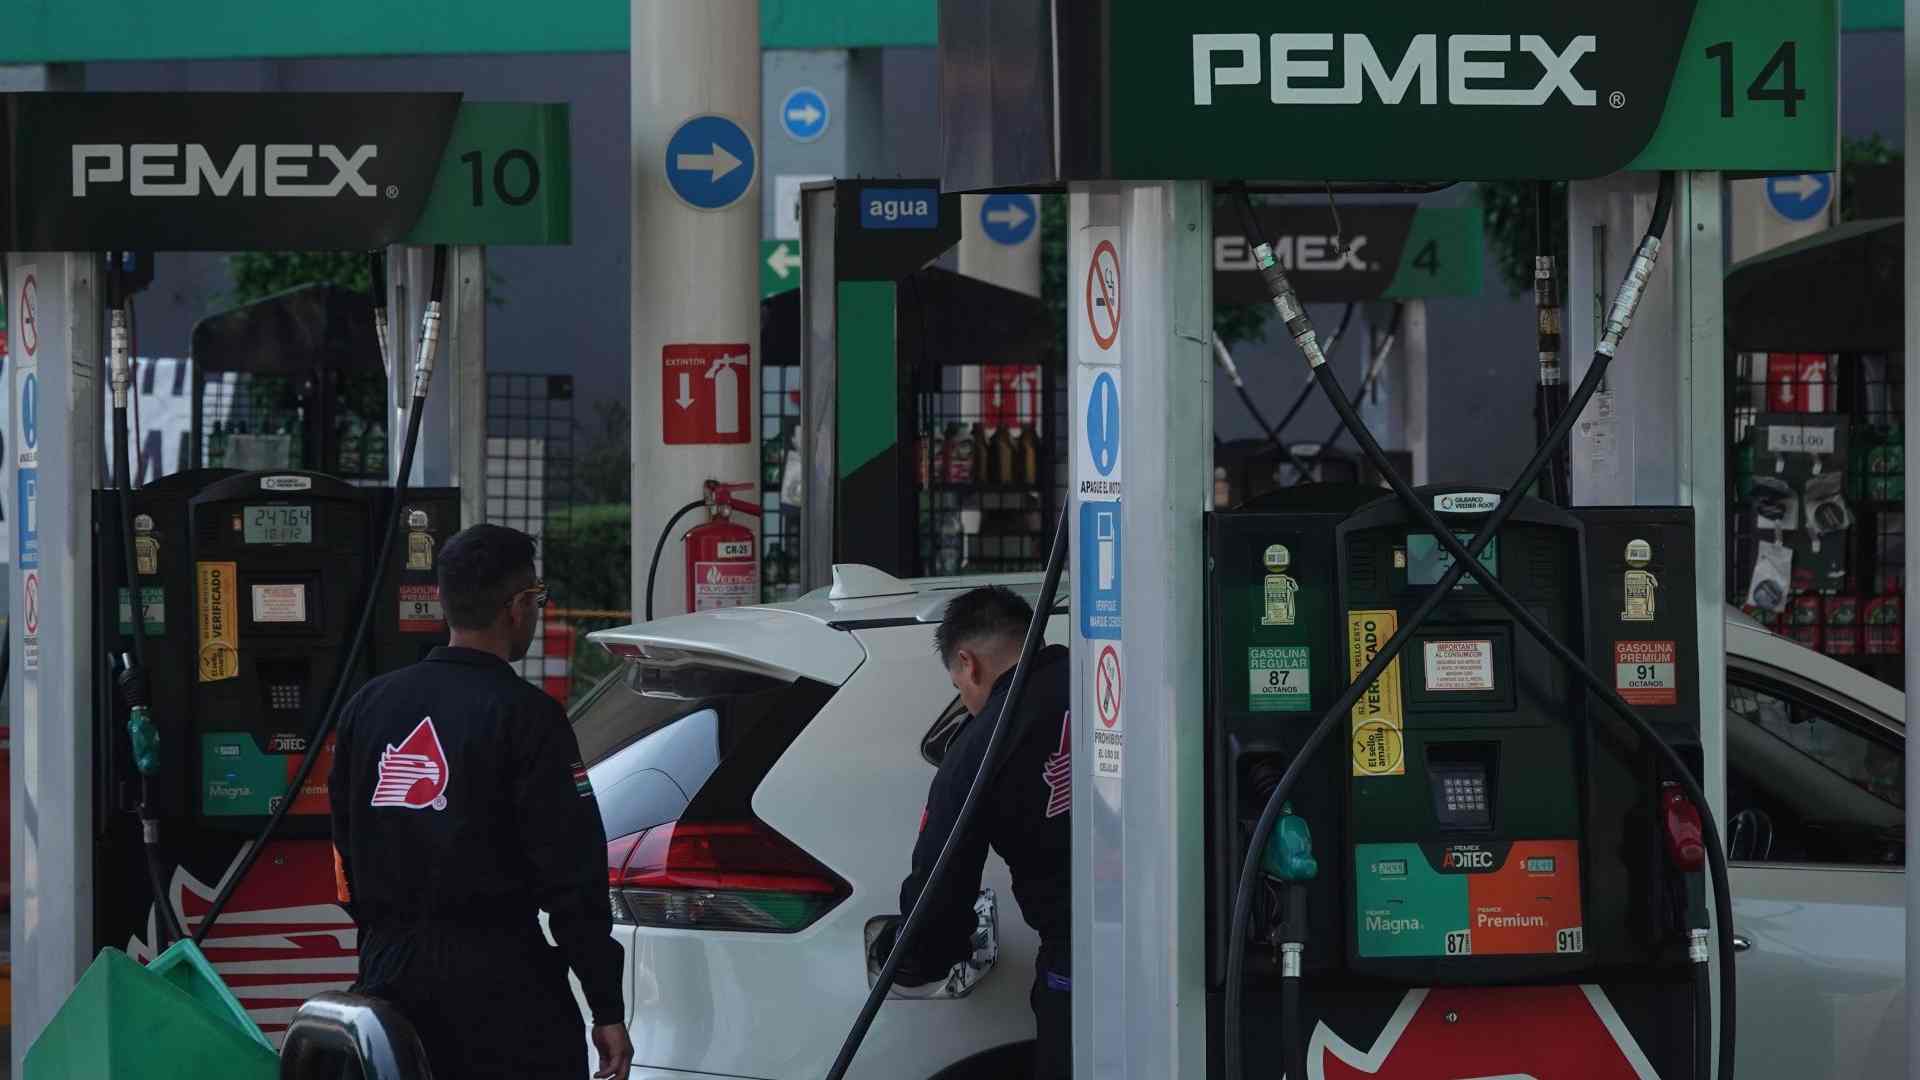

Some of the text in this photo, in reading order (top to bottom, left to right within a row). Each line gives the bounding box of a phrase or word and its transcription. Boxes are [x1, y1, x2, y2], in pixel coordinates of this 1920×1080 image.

[1193, 33, 1597, 105] PEMEX
[1704, 41, 1806, 118] 14
[72, 144, 377, 197] PEMEX
[461, 149, 541, 206] 10
[870, 199, 928, 221] agua
[1214, 236, 1367, 271] EMEX
[1412, 240, 1441, 276] 4
[211, 569, 223, 640] VERIFICADO
[414, 602, 429, 614] 91
[1251, 649, 1307, 658] GASOLINA
[1617, 643, 1673, 653] GASOLINA
[1620, 653, 1671, 663] PREMIUM
[1251, 658, 1307, 668] REGULAR
[1364, 620, 1381, 715] VERCADO
[1637, 664, 1655, 680] 91
[1269, 670, 1290, 686] 87
[1366, 734, 1377, 767] El sello
[1375, 727, 1386, 767] amarillo
[1365, 916, 1420, 935] Magna
[1477, 913, 1544, 929] Premium
[1447, 933, 1465, 954] 87
[1558, 931, 1575, 952] 91
